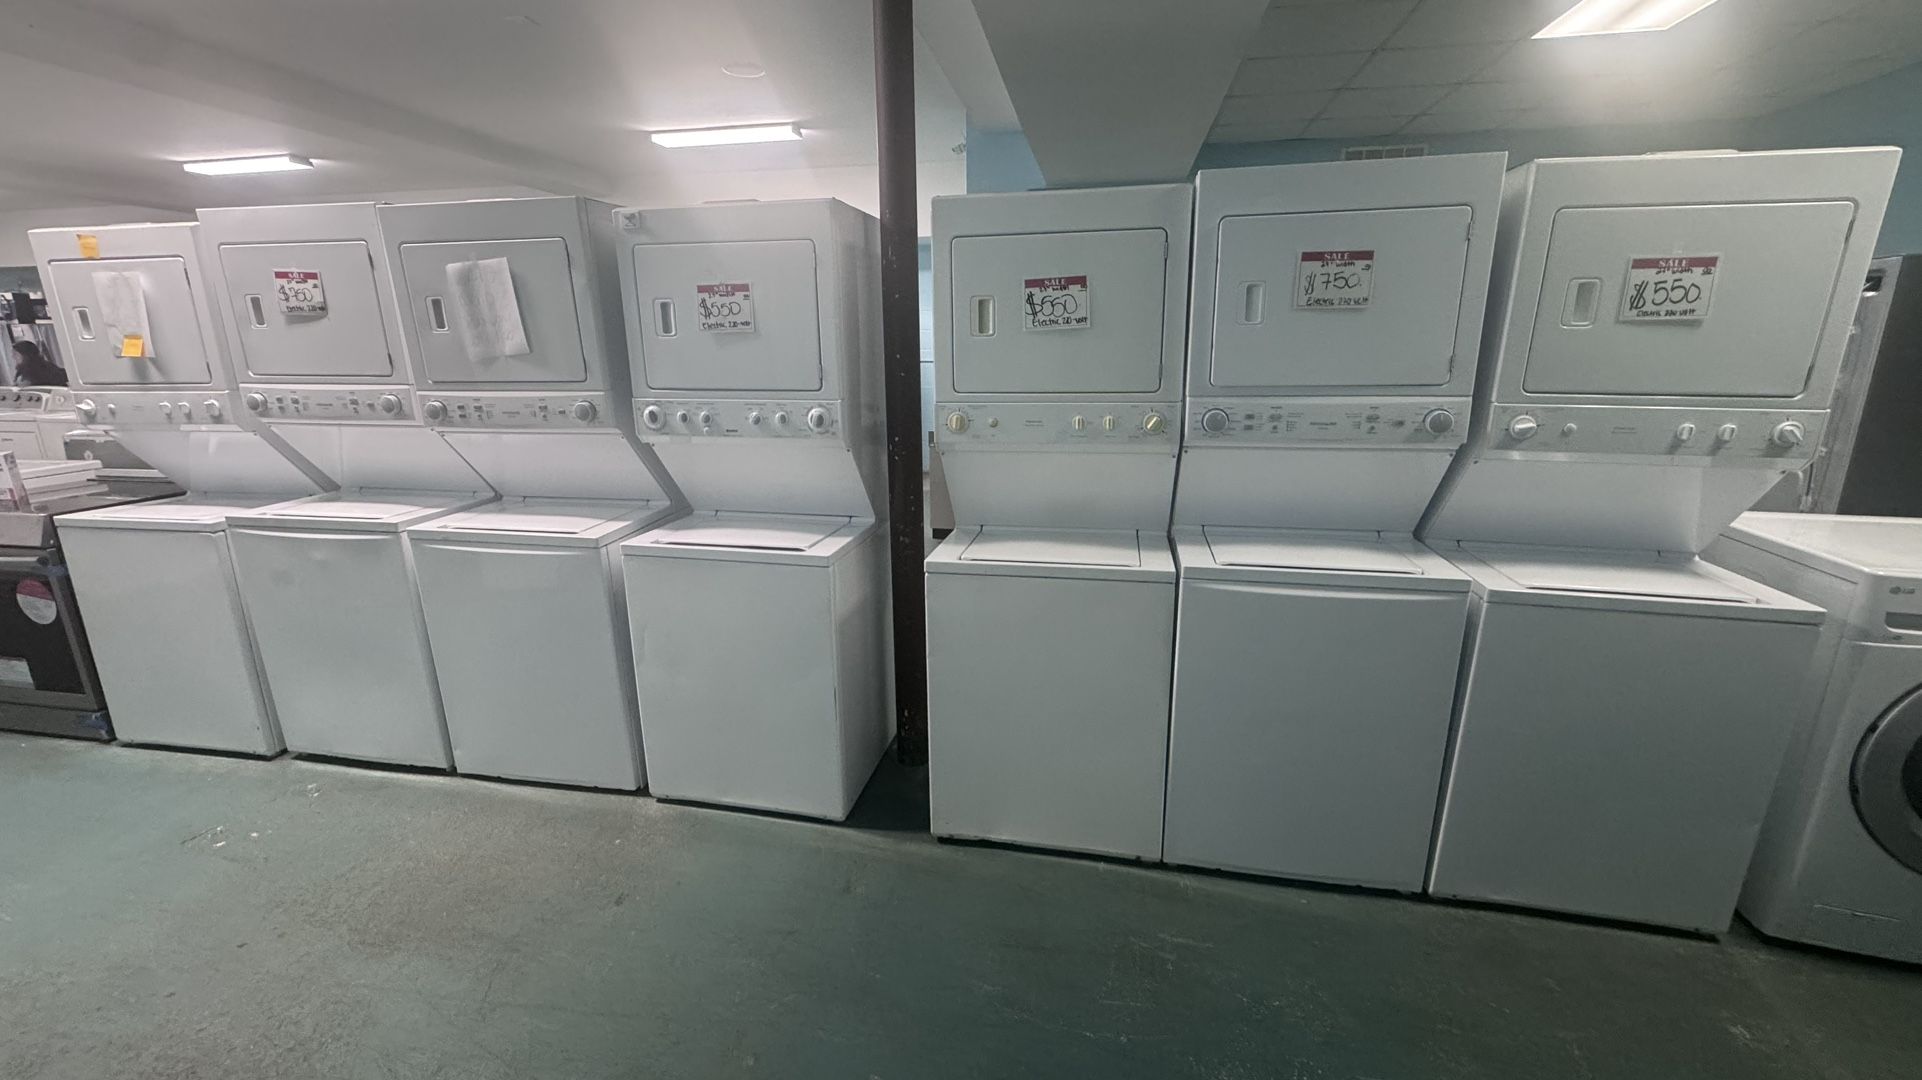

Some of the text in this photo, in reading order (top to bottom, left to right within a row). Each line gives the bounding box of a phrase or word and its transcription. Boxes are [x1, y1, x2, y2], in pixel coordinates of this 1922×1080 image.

[1324, 252, 1350, 260] SALE
[1659, 258, 1687, 267] SALE
[1044, 278, 1066, 286] SALE
[700, 297, 741, 320] $550
